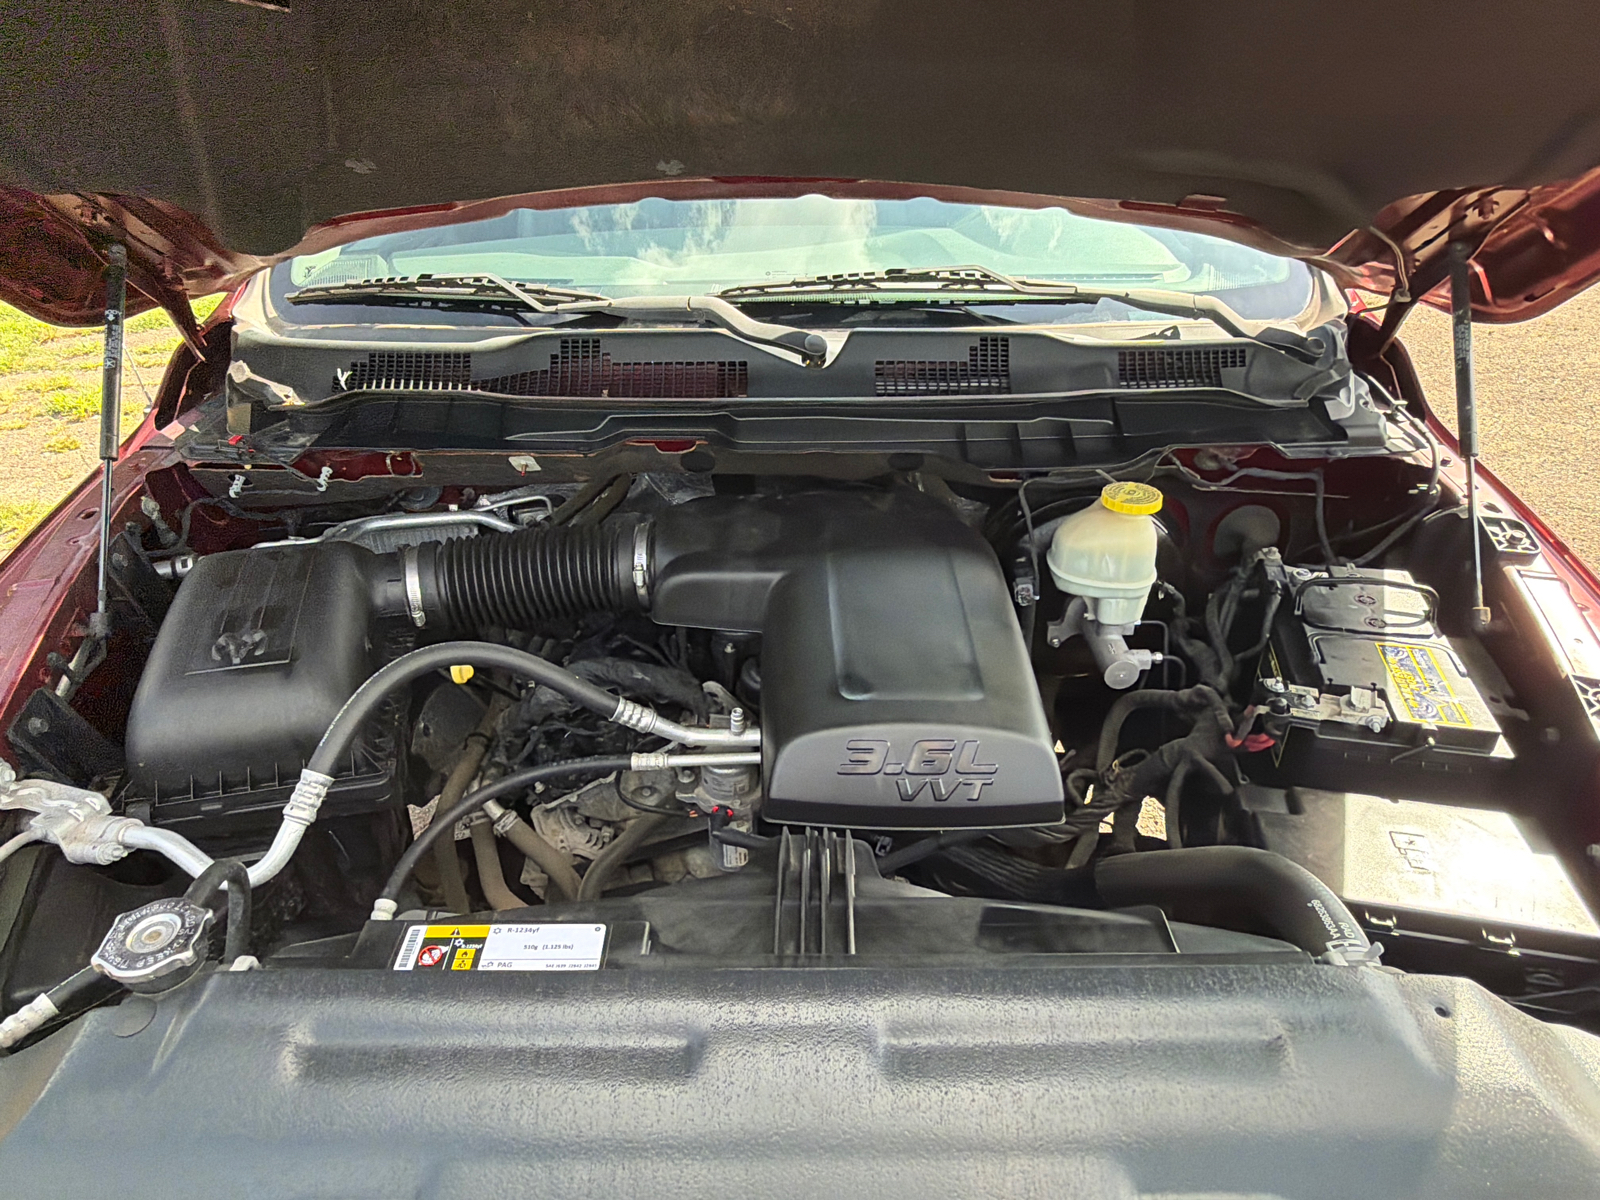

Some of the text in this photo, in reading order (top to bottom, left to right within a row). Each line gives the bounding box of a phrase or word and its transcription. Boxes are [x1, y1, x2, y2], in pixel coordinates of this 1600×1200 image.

[837, 739, 999, 776] 3.6L
[895, 777, 994, 802] VVT
[1338, 921, 1355, 939] RAD
